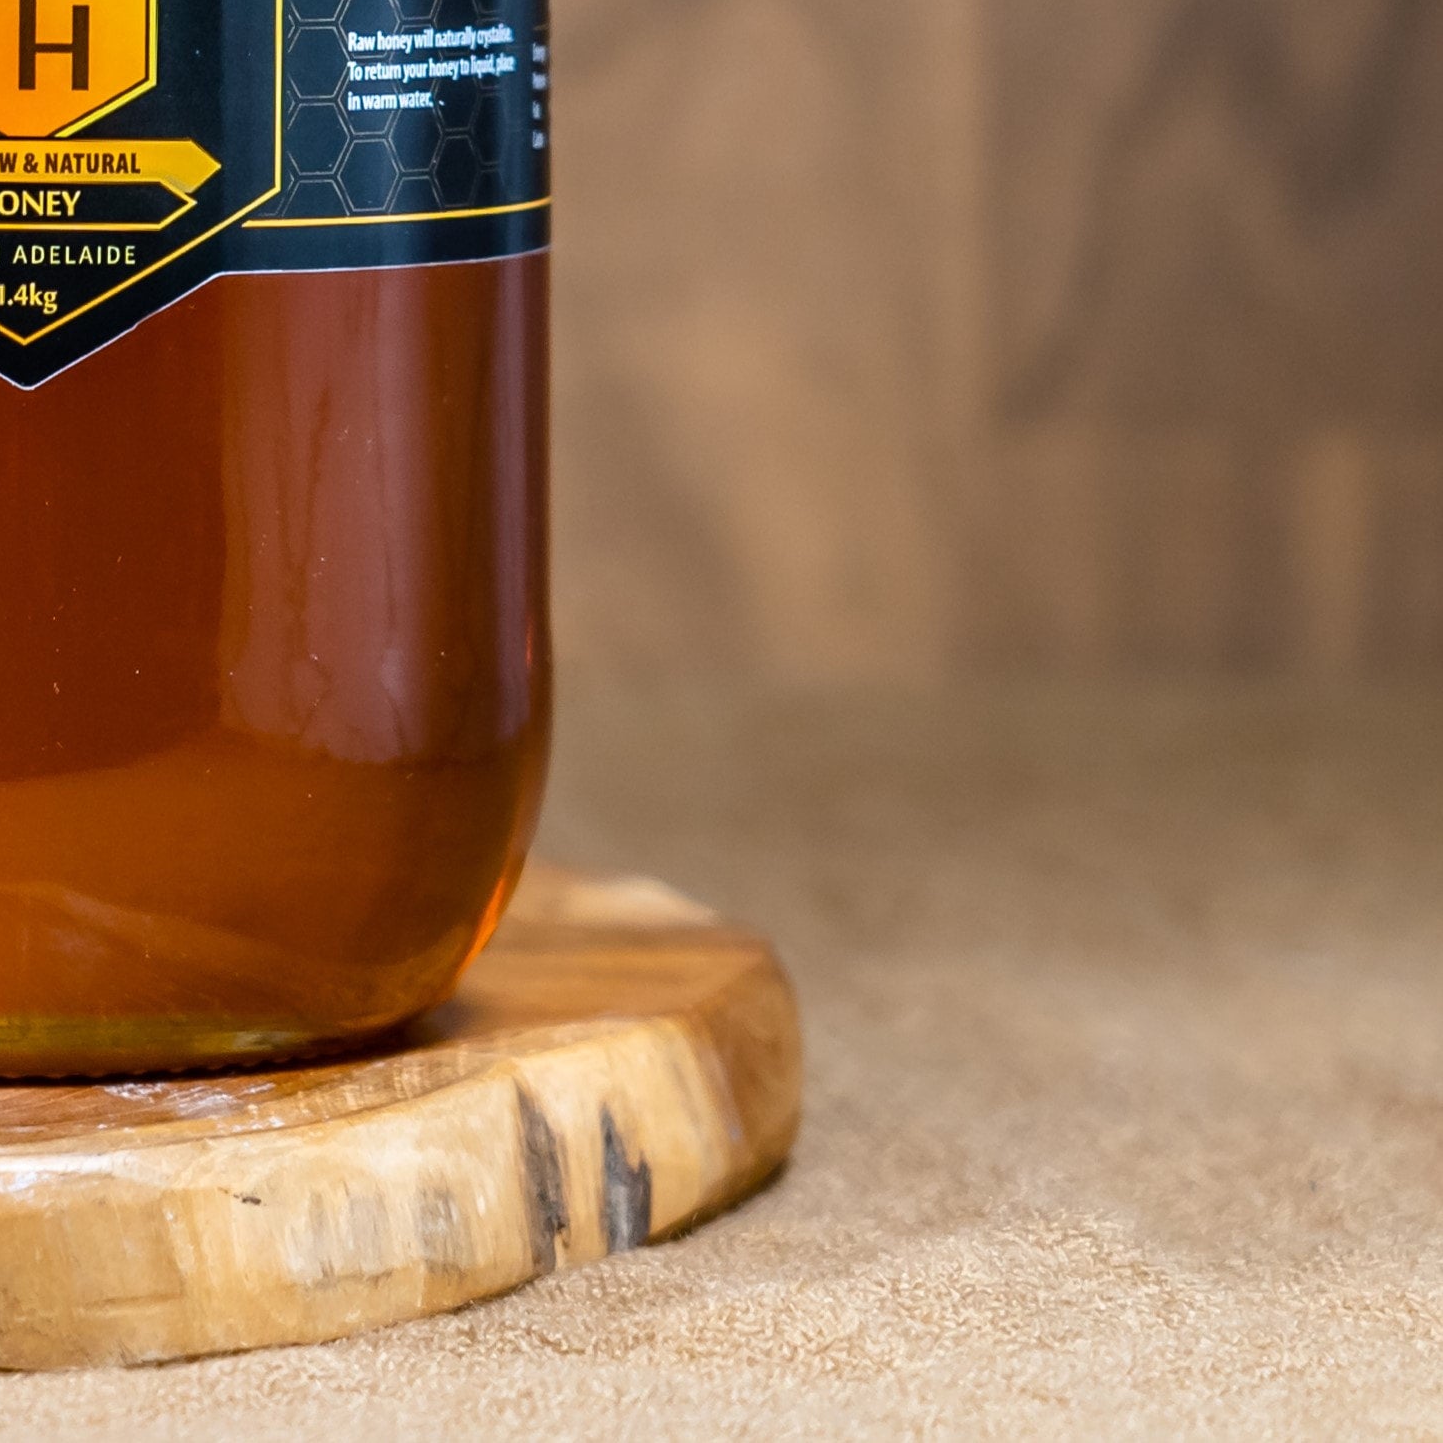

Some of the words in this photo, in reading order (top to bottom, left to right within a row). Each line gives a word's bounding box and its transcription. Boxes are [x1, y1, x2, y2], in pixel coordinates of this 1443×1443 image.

[347, 31, 376, 52] Raw
[377, 31, 413, 54] honey
[414, 28, 434, 48] will
[435, 26, 477, 49] naturally
[347, 61, 363, 81] To
[364, 63, 402, 81] return
[403, 64, 428, 83] your
[429, 58, 459, 80] honey
[460, 58, 470, 75] to
[347, 92, 362, 111] in
[362, 95, 398, 110] warm
[399, 91, 434, 108] water.
[23, 152, 39, 173] &
[44, 152, 141, 174] NATURAL
[13, 244, 137, 265] ADELAIDE
